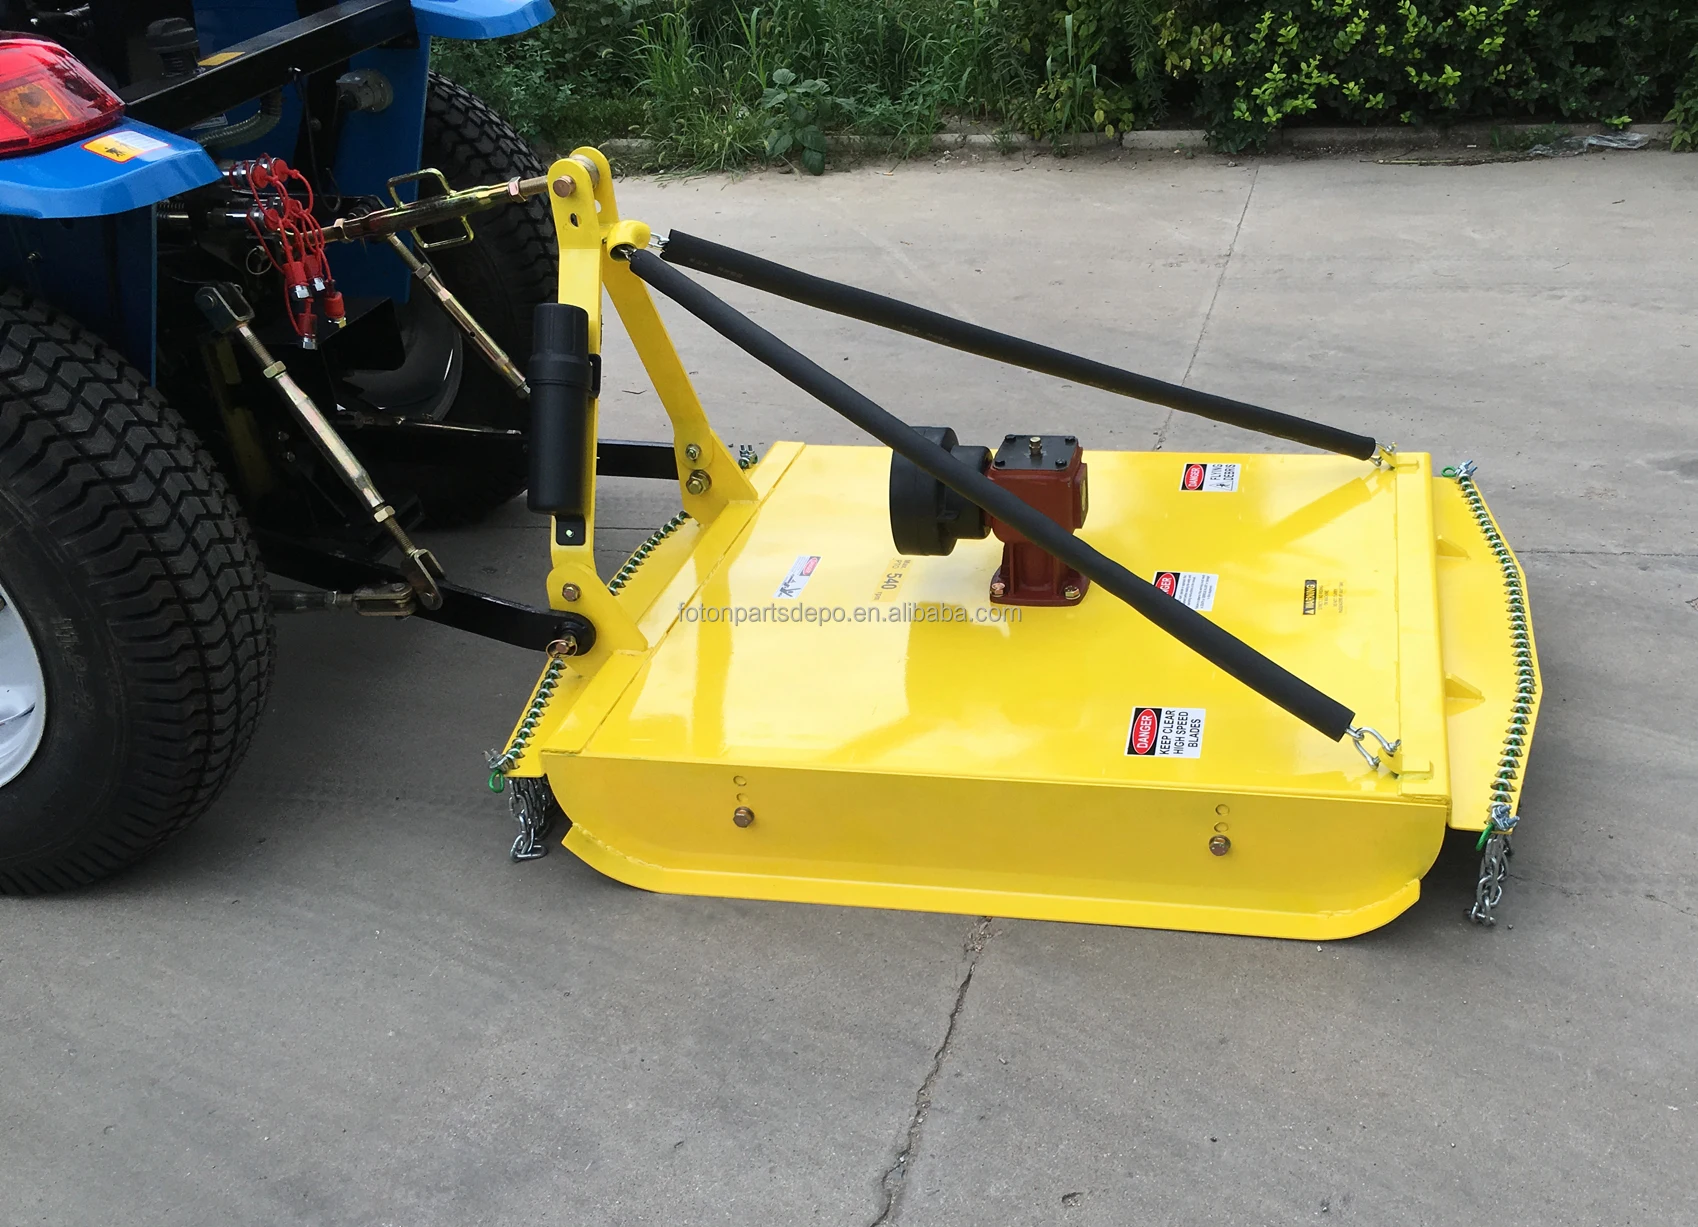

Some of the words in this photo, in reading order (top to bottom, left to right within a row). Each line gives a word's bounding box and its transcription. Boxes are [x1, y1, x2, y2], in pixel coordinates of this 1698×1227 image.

[1210, 464, 1223, 481] FLYING
[1223, 464, 1236, 481] DEBRIS
[881, 573, 903, 590] 540
[1136, 715, 1153, 749] DANGER
[1162, 710, 1176, 734] CLEAR
[1176, 711, 1189, 735] SPEED
[1188, 718, 1201, 748] BLADES
[1159, 735, 1171, 755] KEEP
[1173, 736, 1185, 755] HIGH
